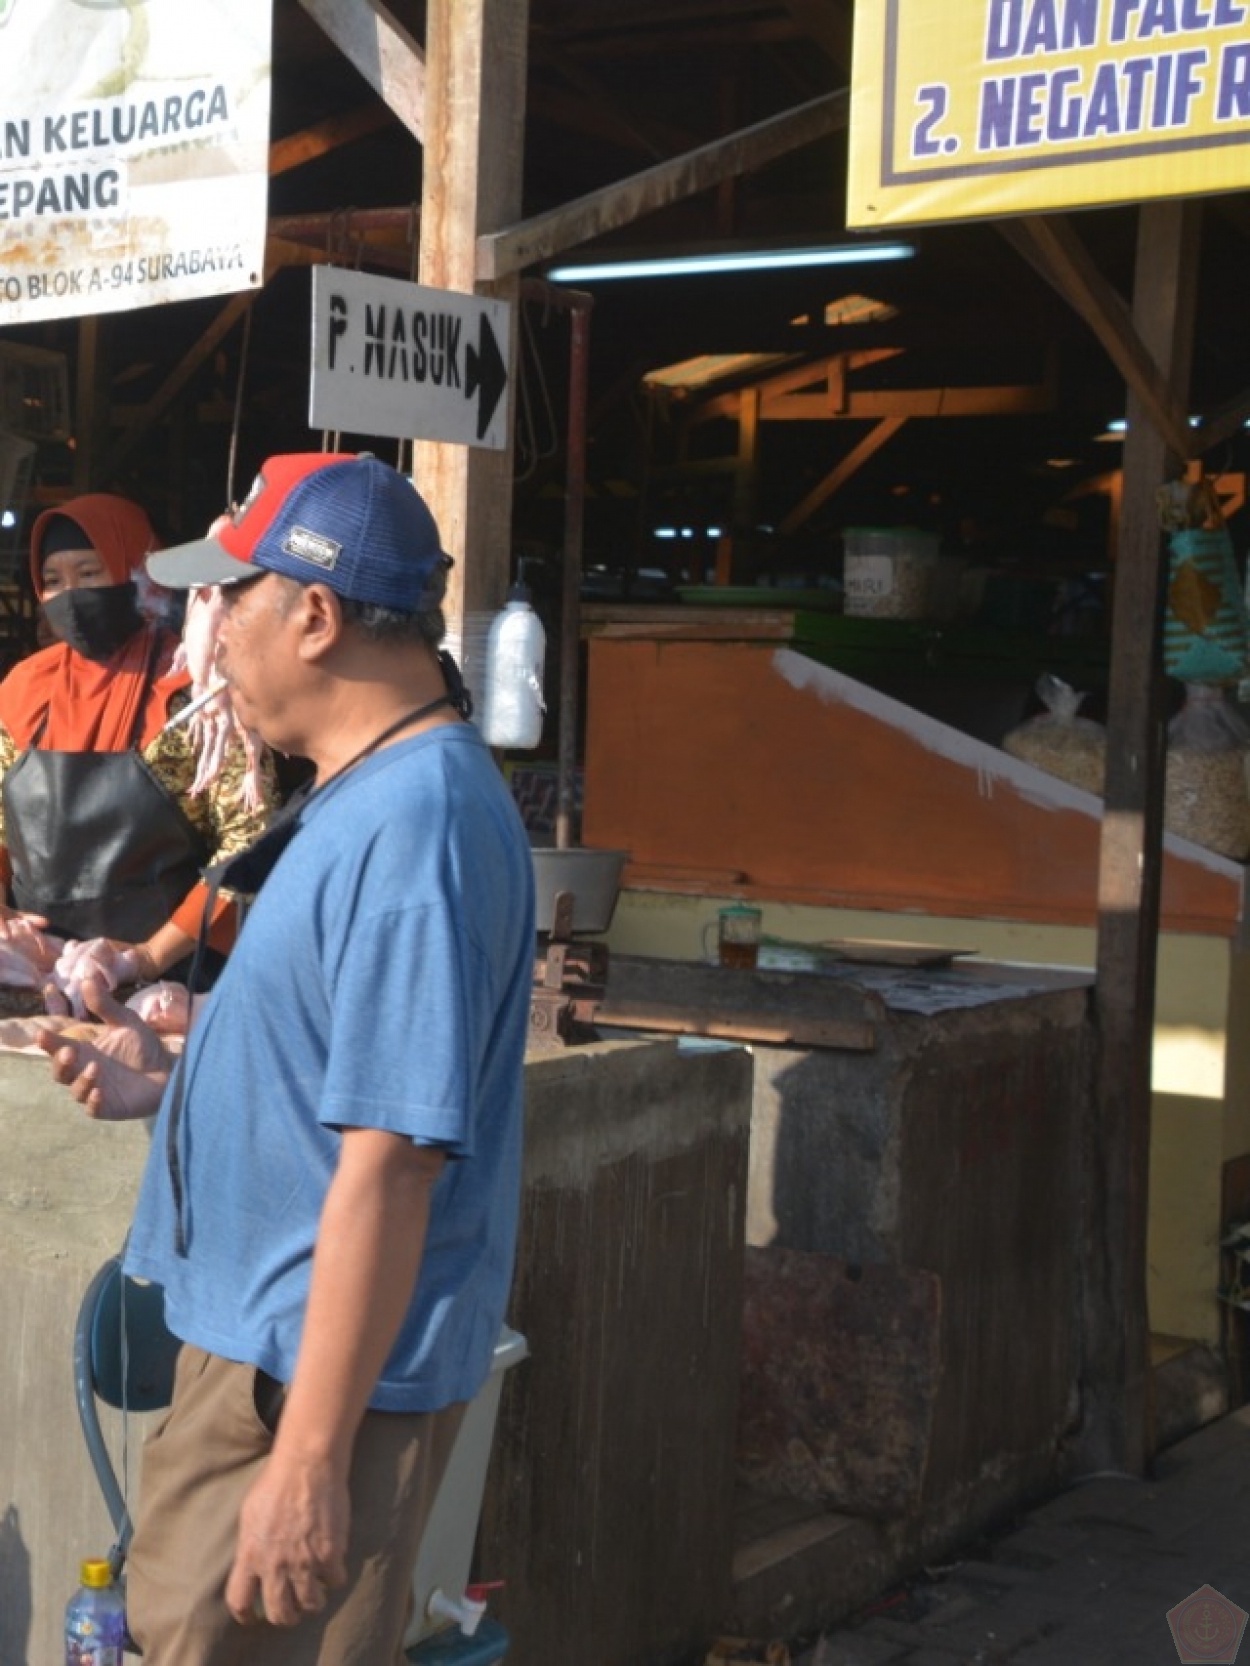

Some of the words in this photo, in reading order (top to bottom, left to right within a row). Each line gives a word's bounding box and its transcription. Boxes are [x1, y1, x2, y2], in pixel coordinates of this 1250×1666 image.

[985, 0, 1098, 61] DAN
[43, 84, 229, 153] KELUARGA
[912, 85, 958, 157] 2.
[977, 49, 1208, 150] NEGATIF
[27, 268, 83, 300] BLOK
[88, 260, 134, 291] A-94
[327, 293, 355, 374] P.
[364, 302, 462, 390] MASUK
